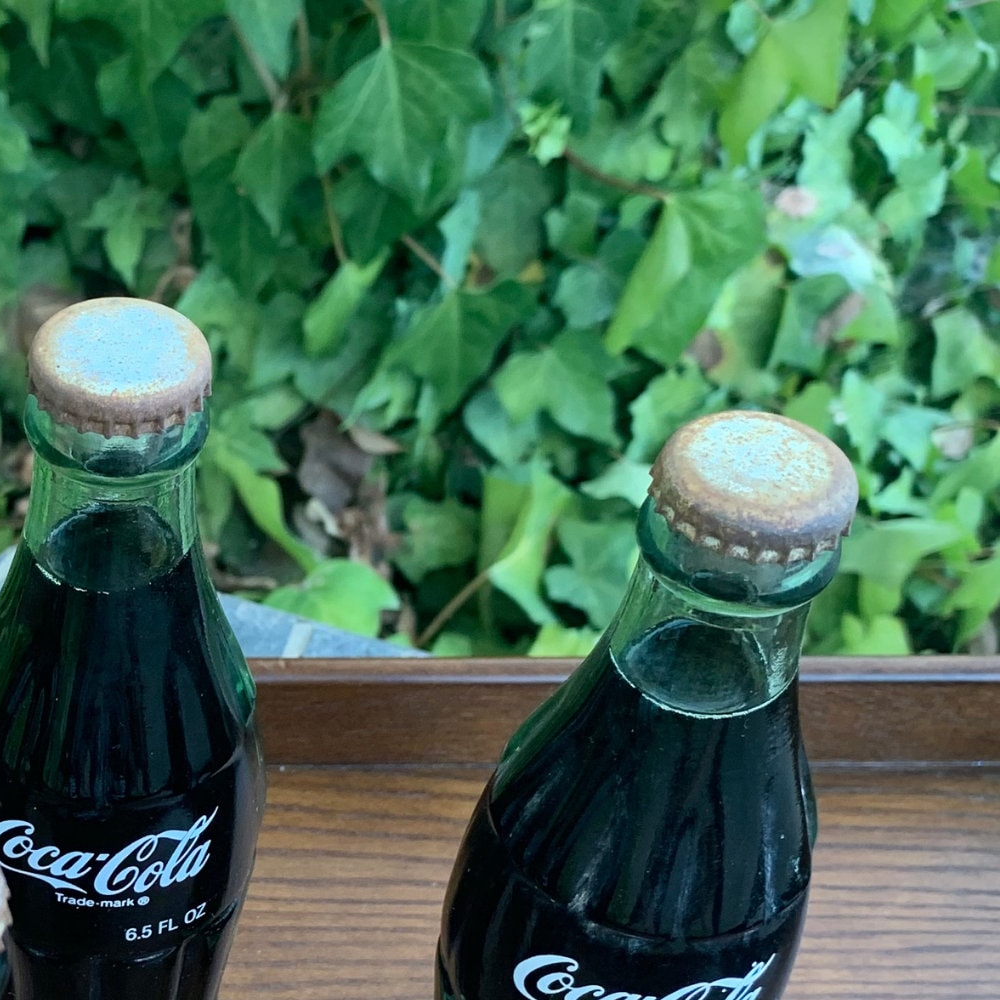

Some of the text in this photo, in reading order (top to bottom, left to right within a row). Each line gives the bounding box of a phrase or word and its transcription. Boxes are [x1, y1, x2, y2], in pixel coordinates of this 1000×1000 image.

[125, 902, 208, 942] 6.5 FL OZ
